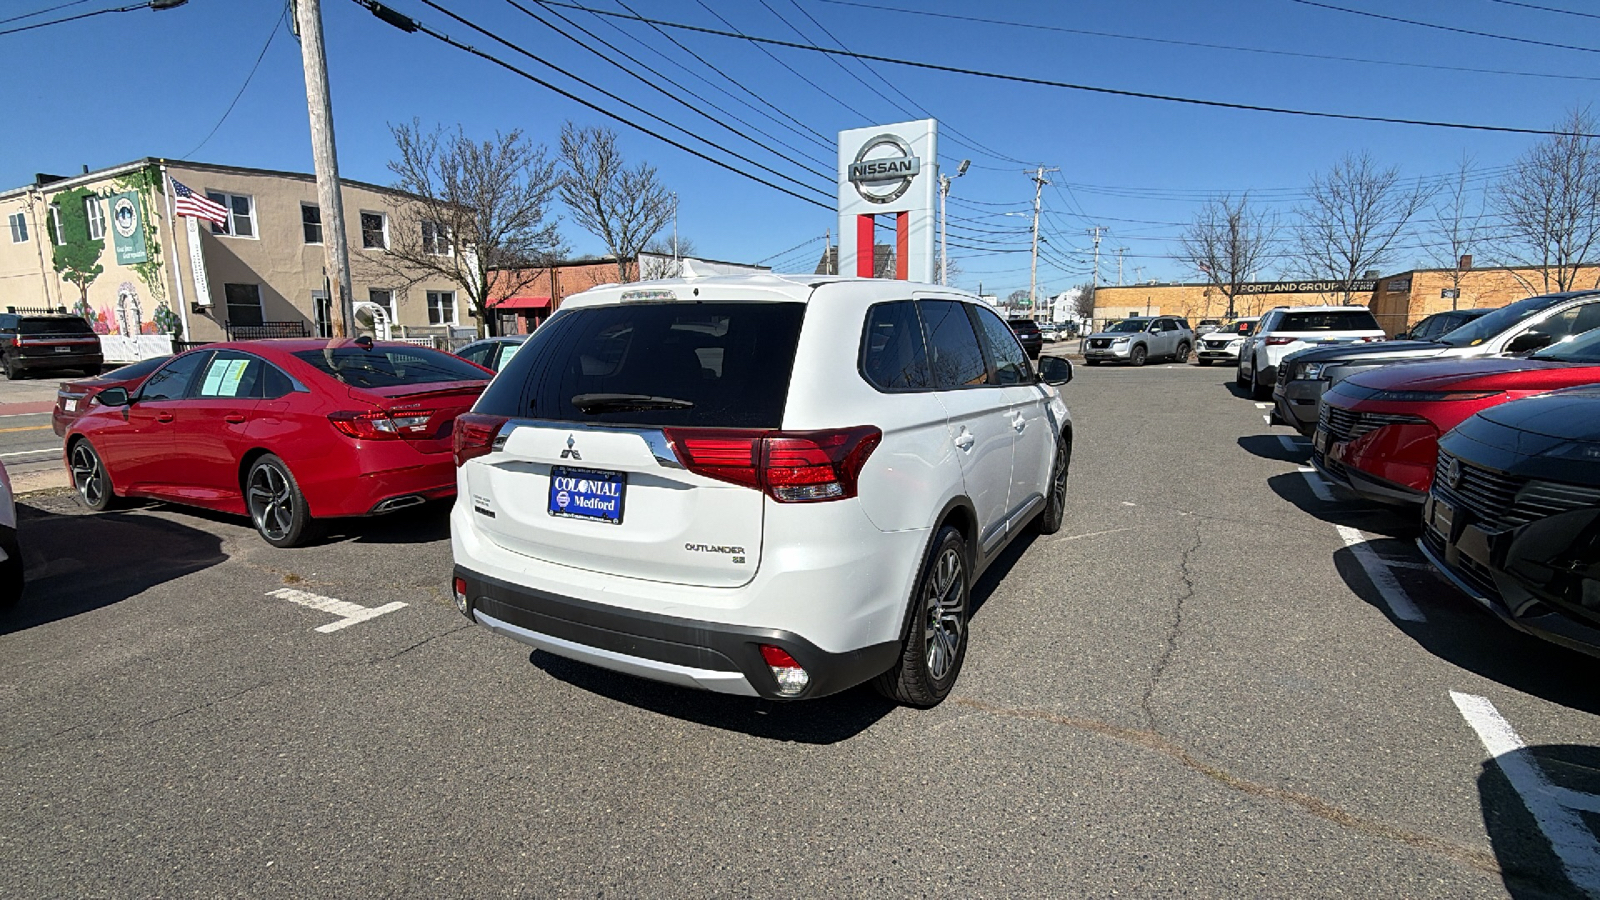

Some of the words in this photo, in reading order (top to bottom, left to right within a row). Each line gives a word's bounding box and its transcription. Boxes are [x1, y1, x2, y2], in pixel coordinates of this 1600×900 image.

[853, 160, 912, 176] NISSAN
[1240, 283, 1297, 293] PORTLAND
[1298, 282, 1339, 291] GROUP
[574, 495, 615, 511] Medford
[685, 543, 746, 554] OUTLANDER
